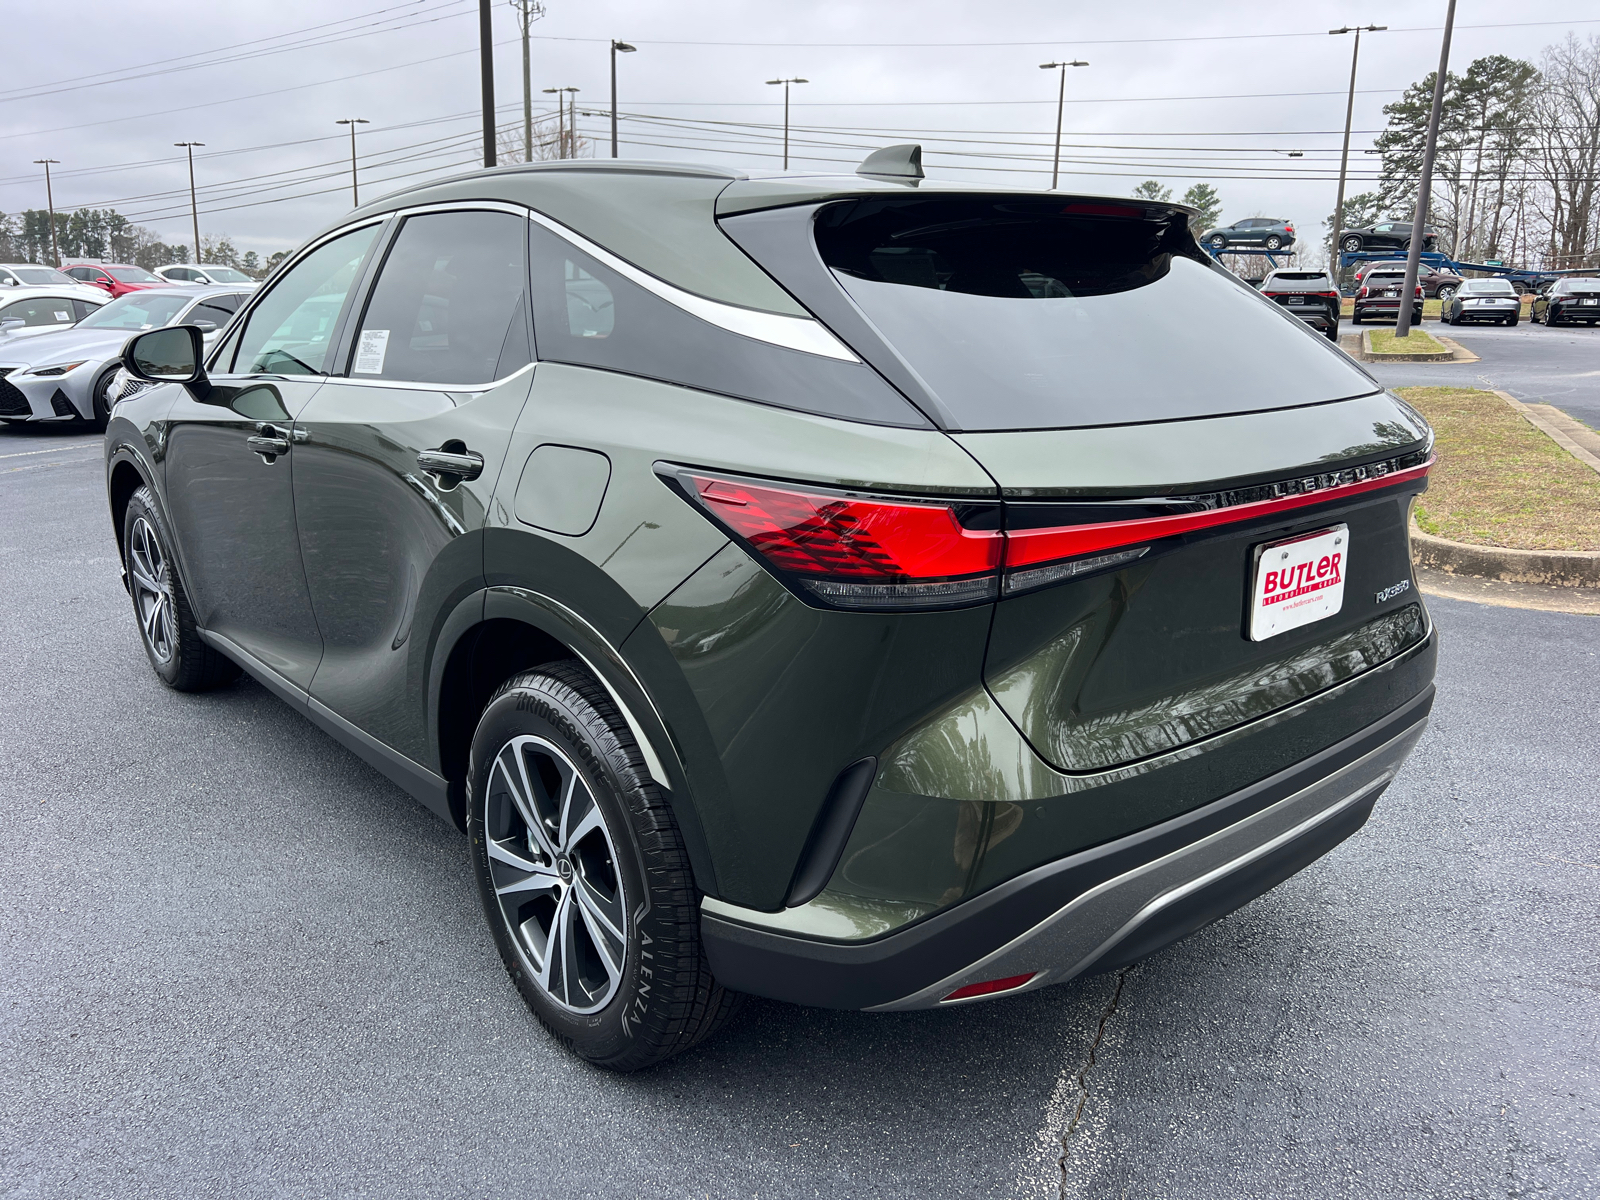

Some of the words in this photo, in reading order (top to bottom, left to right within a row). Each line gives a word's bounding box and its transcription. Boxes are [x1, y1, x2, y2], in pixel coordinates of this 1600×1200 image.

[1274, 464, 1388, 496] LEXUS
[1263, 585, 1312, 606] AUTOMOTIVE
[1318, 576, 1341, 589] GROUP
[1374, 579, 1409, 604] RX350
[514, 691, 608, 787] BRIDGESTONE
[630, 929, 654, 1024] ALENZA
